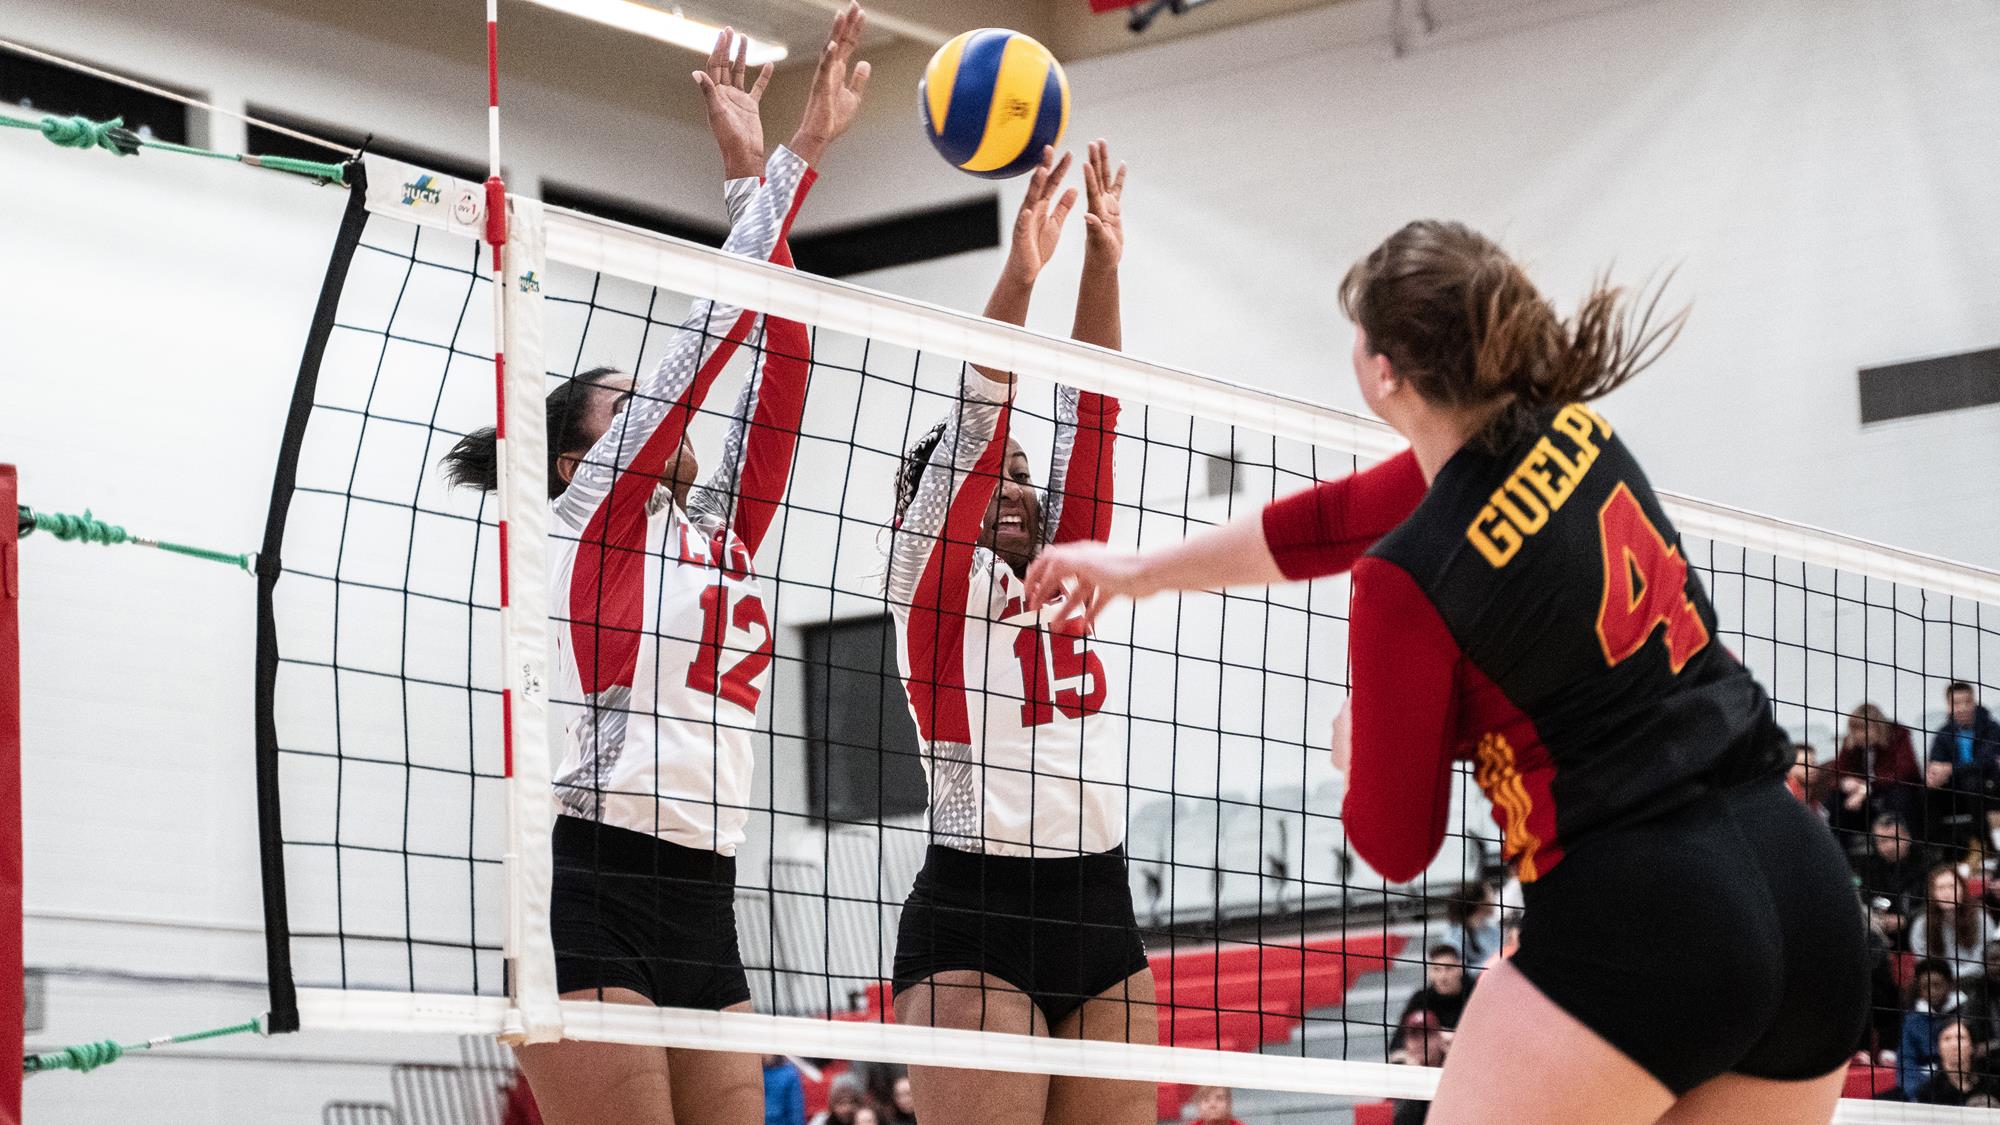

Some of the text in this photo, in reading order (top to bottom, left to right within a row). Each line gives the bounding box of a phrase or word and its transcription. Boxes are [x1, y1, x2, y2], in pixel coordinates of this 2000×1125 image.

[402, 184, 440, 205] HUCK
[1595, 480, 1710, 676] 4
[685, 584, 773, 715] 12
[1013, 620, 1107, 728] 15
